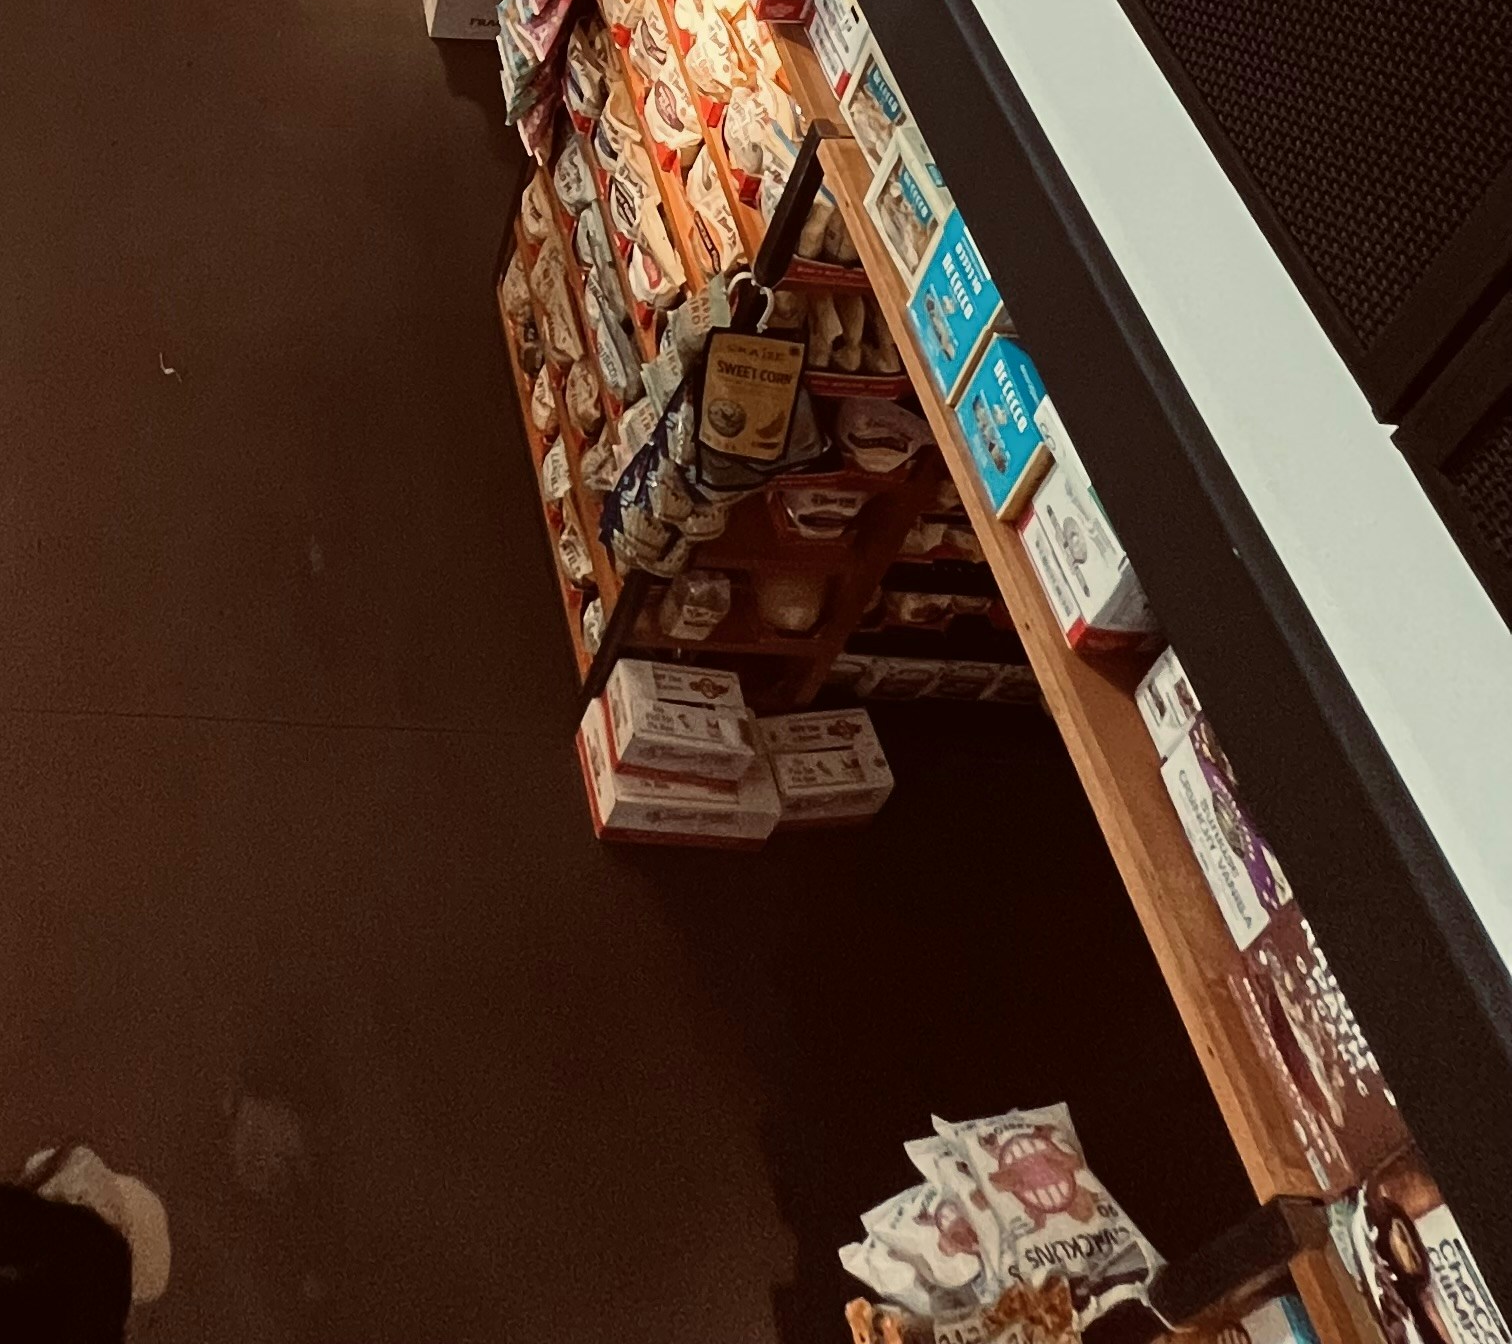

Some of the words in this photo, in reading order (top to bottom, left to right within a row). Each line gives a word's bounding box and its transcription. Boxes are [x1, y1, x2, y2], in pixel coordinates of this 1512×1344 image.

[716, 360, 758, 381] SWEET
[993, 359, 1008, 387] DE
[1002, 379, 1028, 433] CECCO
[1217, 856, 1252, 929] VANILLA
[1295, 955, 1370, 1098] ORGANIC
